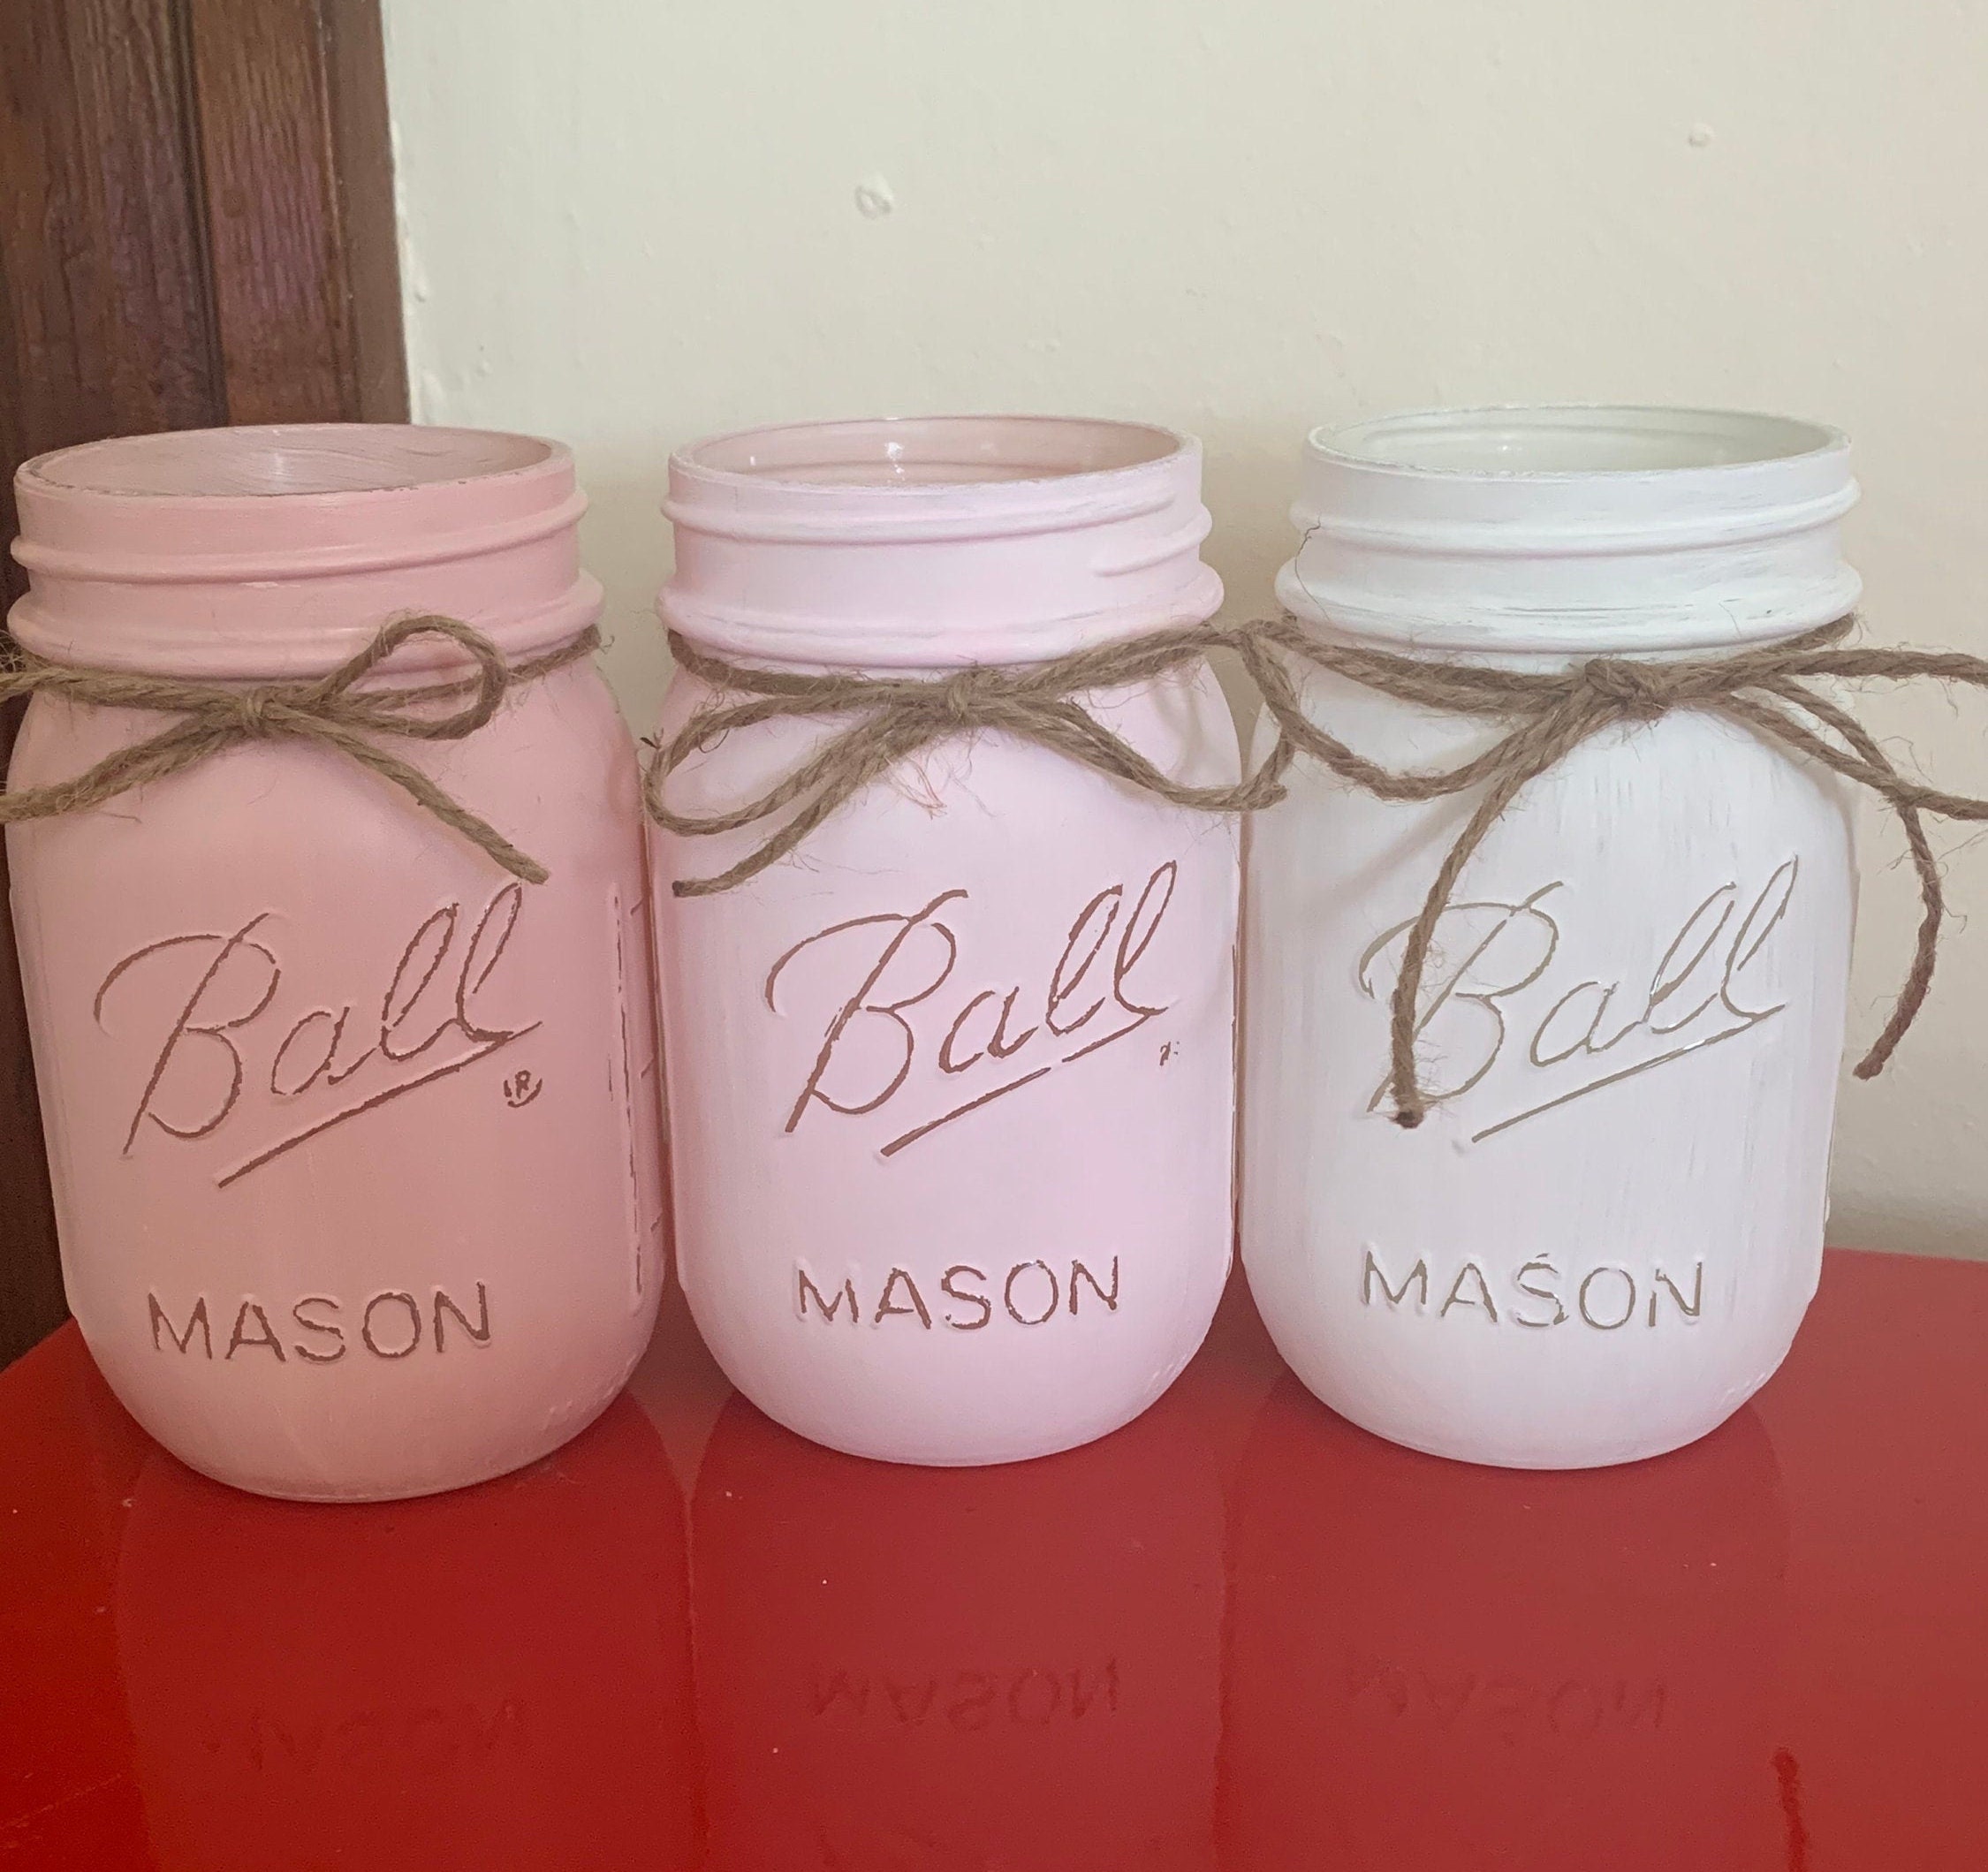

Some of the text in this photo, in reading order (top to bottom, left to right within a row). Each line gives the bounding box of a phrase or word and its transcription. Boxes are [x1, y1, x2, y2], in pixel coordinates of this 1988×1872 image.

[95, 883, 543, 1186] Ball
[766, 860, 1169, 1157] Ball
[1359, 854, 1799, 1143] Ball
[147, 1281, 491, 1361] MASON
[798, 1255, 1119, 1330] MASON
[1362, 1251, 1703, 1330] MASON
